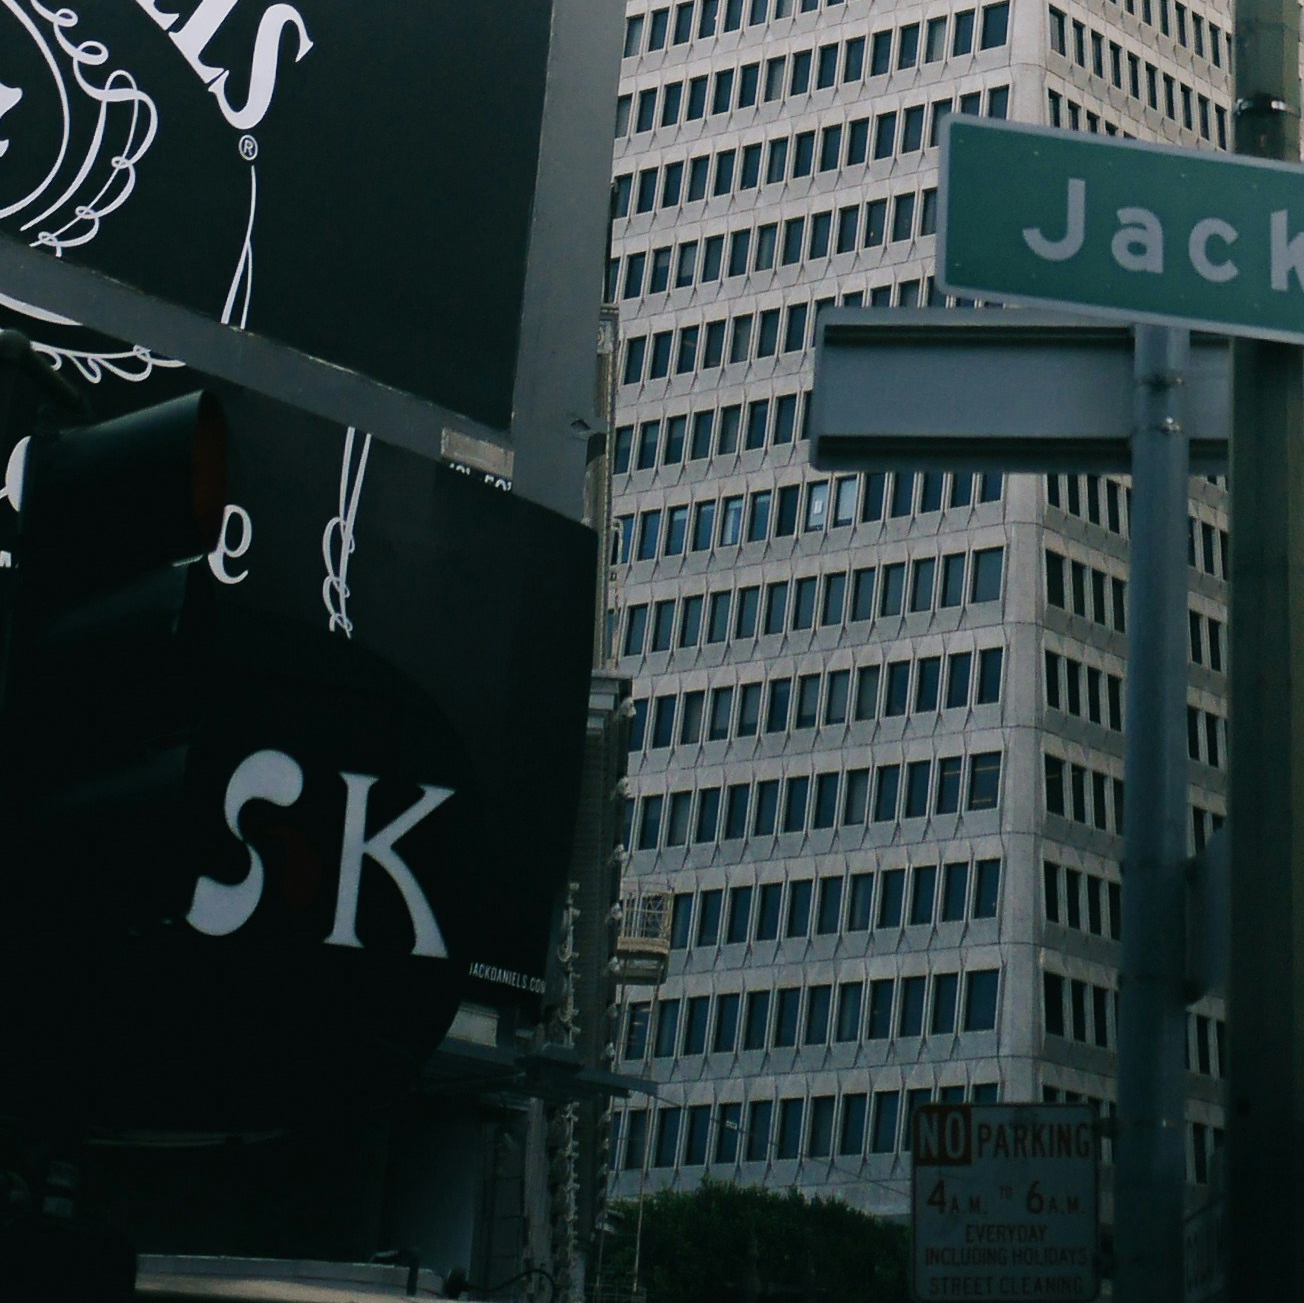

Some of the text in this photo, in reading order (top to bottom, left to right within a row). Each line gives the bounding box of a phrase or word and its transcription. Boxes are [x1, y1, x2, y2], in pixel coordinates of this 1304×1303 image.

[918, 1110, 1091, 1160] NO PARKING
[999, 1186, 1014, 1200] TO
[966, 1224, 1047, 1243] EVERYDAY
[925, 1247, 1088, 1266] INCLUDING HOLIDAYS
[929, 1276, 1083, 1296] STREET CLEANING
